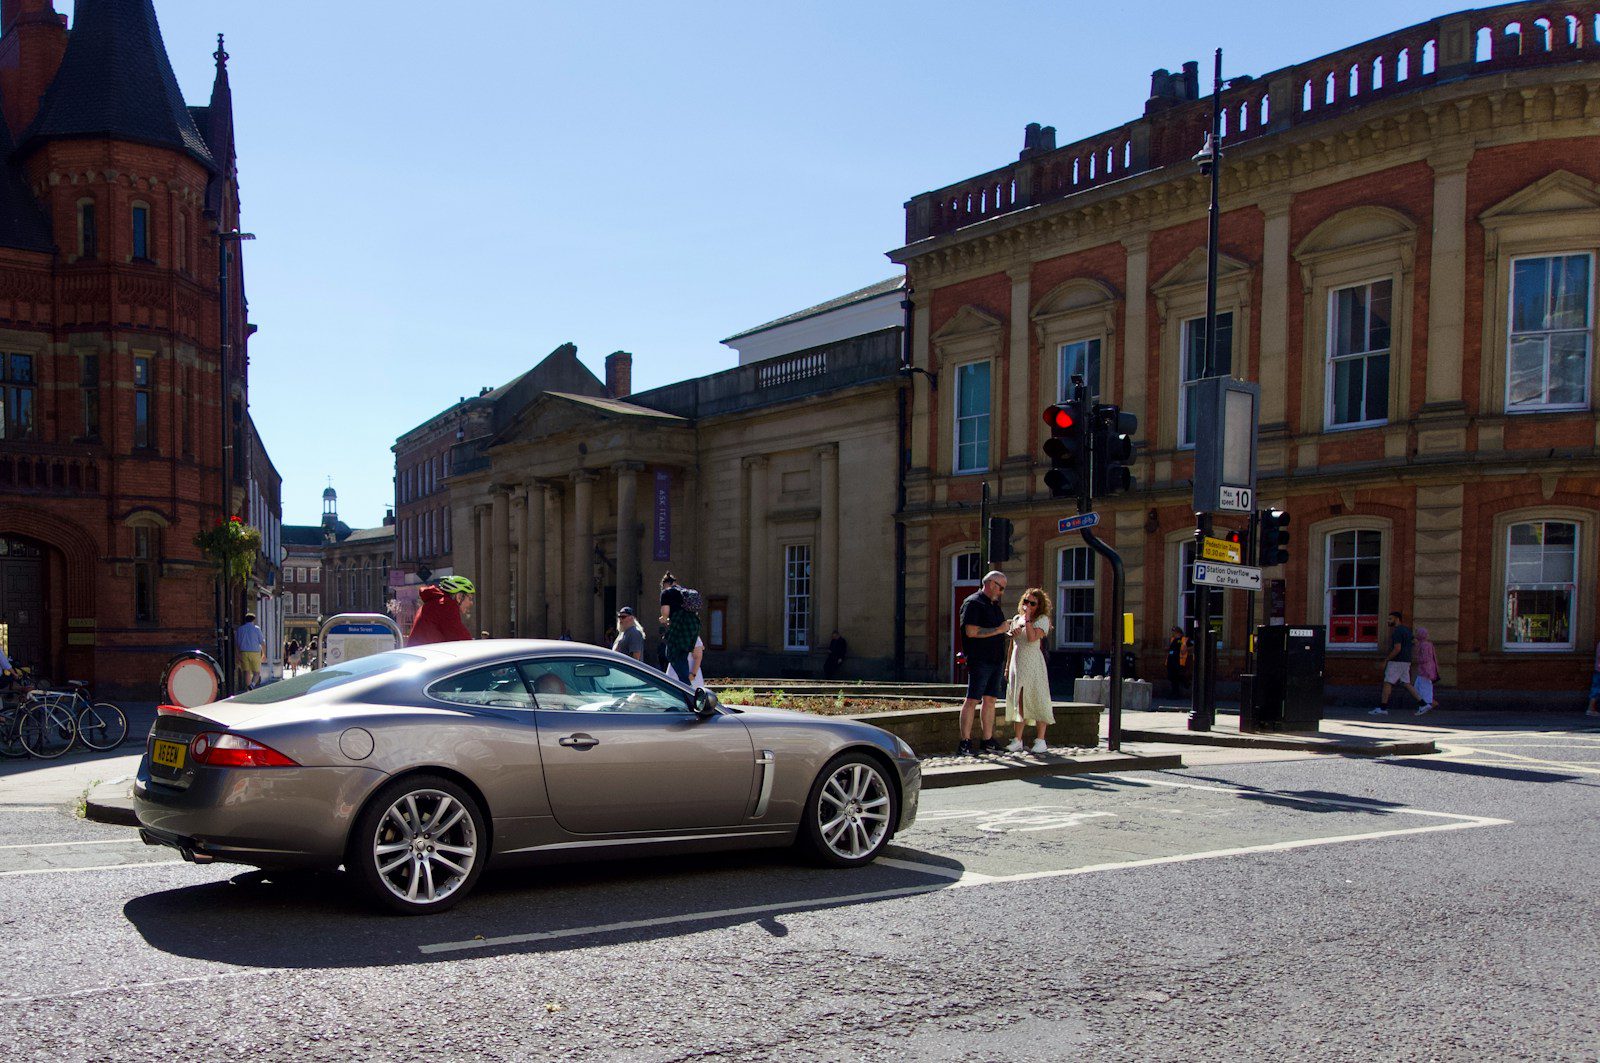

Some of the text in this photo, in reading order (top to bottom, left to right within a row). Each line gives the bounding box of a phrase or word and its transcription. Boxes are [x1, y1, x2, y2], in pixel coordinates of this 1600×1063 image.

[1236, 490, 1249, 508] 10
[1206, 566, 1250, 576] Station Overflow
